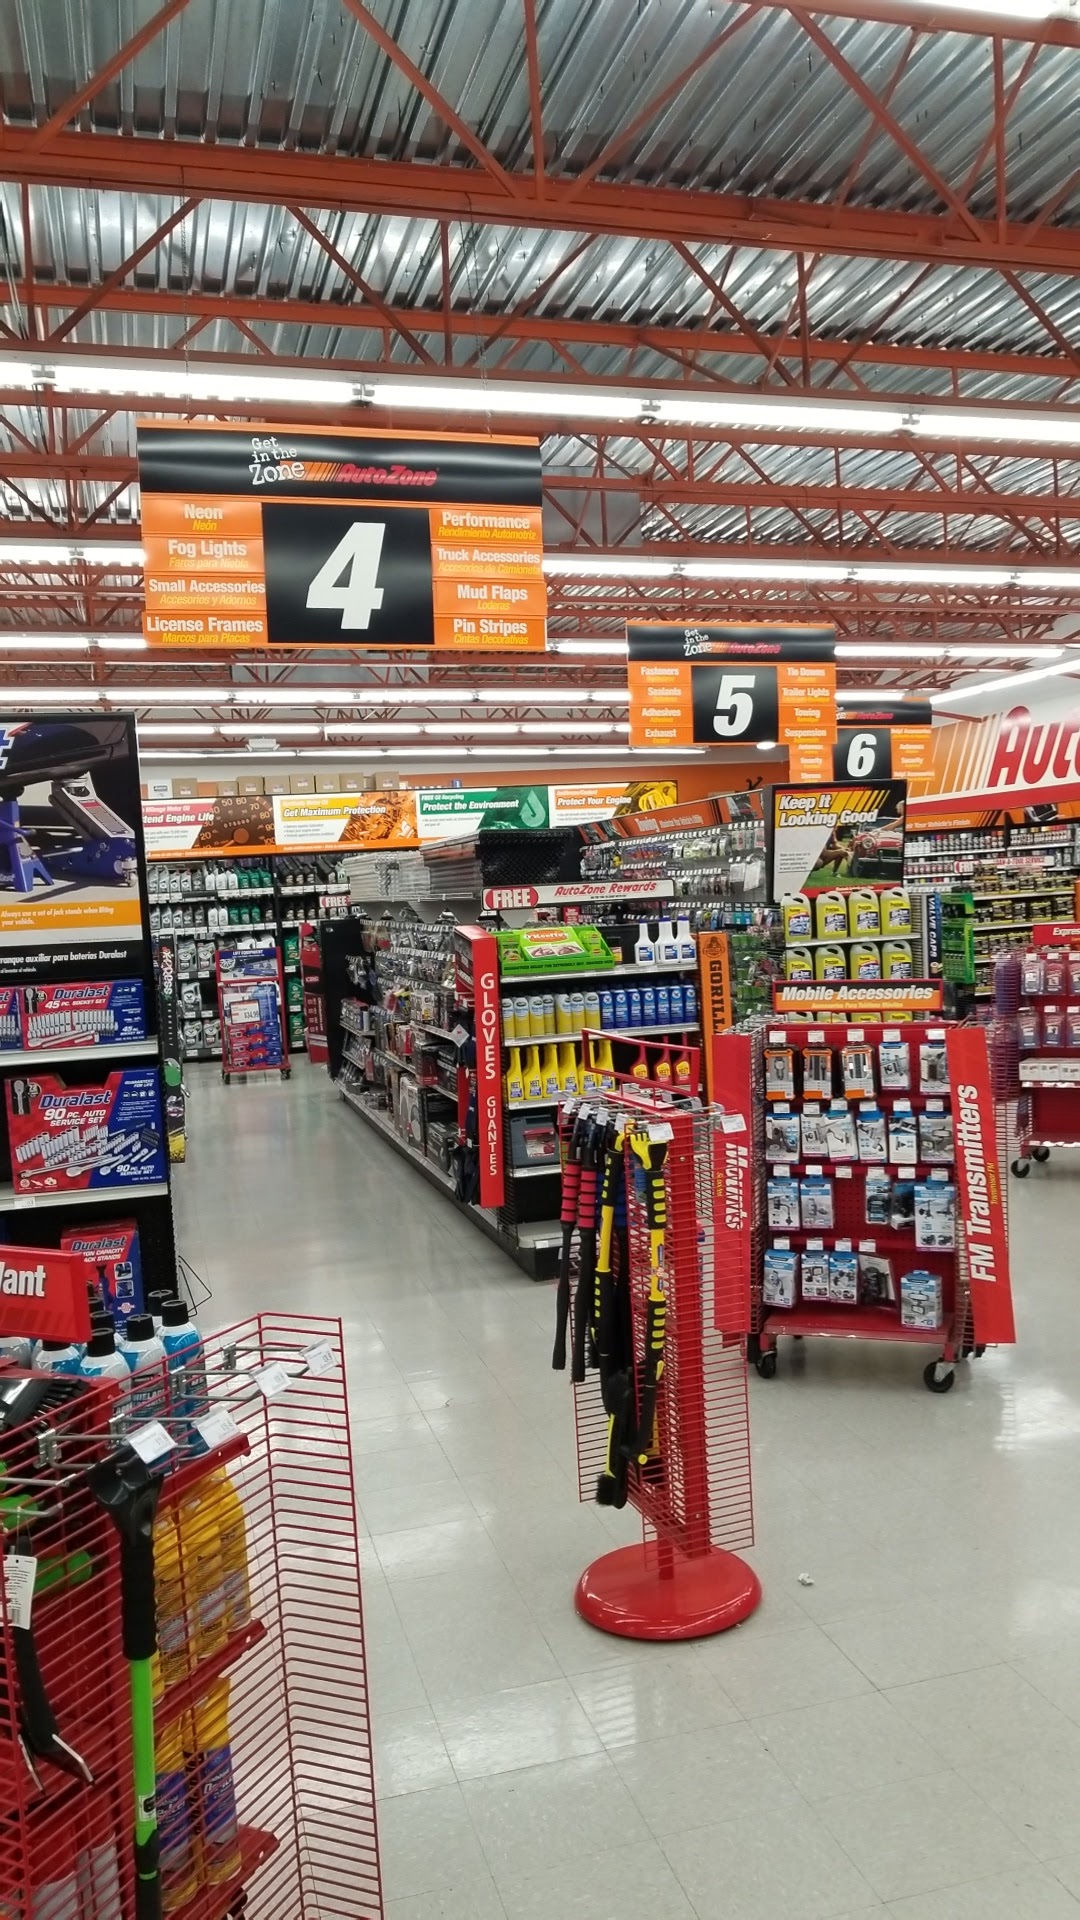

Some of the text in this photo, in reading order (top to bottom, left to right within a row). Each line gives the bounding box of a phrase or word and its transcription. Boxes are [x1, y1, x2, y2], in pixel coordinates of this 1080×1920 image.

[251, 436, 278, 449] Get
[252, 447, 298, 463] in the
[249, 461, 305, 485] Zone
[336, 463, 437, 486] AutoZone
[184, 504, 223, 520] Neon
[193, 520, 216, 531] Neón
[442, 512, 530, 529] Performance
[438, 527, 536, 540] Rendimiento Automotriz
[168, 540, 247, 558] Fog Lights
[436, 548, 540, 563] Truck Accessories
[197, 559, 219, 570] para
[486, 564, 496, 574] de
[306, 521, 386, 630] 4
[149, 580, 266, 594] Small Accessories
[457, 585, 528, 602] Mud Flaps
[160, 594, 256, 607] Accesorios y Adornos
[478, 601, 510, 611] Loderas
[147, 618, 264, 632] License Frames
[453, 619, 527, 636] Pin Stripes
[162, 632, 250, 645] Marcos para Placas
[454, 634, 528, 645] Cintas Decorativas
[684, 642, 712, 656] Zone
[640, 666, 679, 676] Fasteners
[782, 688, 830, 697] Trailer Lights
[642, 708, 681, 717] Adhesives
[713, 674, 756, 737] 5
[794, 708, 821, 718] Towing
[645, 729, 677, 738] Exhaust
[784, 728, 827, 738] Suspension
[846, 734, 877, 777] 6
[222, 799, 233, 807] 50
[236, 797, 247, 805] 60
[250, 803, 260, 811] 70
[260, 811, 270, 819] 80
[423, 800, 519, 811] Protect the Environment
[557, 796, 632, 806] Protect Your Engine
[779, 794, 832, 812] Keep It
[166, 812, 214, 824] Engine Life
[284, 806, 387, 817] Get Maximum Protection
[780, 808, 879, 827] Looking Good
[326, 897, 347, 906] FREE
[493, 888, 532, 908] FREE
[555, 884, 606, 897] AutoZone
[608, 881, 657, 894] Rewards
[928, 897, 938, 958] VALVE CAPS
[53, 954, 68, 964] para
[99, 950, 127, 959] Duralast
[53, 985, 109, 1000] Duralast
[710, 960, 726, 1034] GORILL
[782, 985, 933, 1001] Mobile Accessories
[45, 1001, 60, 1009] 45
[480, 972, 497, 1080] GLOVES
[39, 1091, 113, 1109] Duralast
[44, 1108, 67, 1121] 90
[50, 1119, 86, 1127] SERVICE
[487, 1096, 498, 1176] GUANTES
[116, 1165, 131, 1173] 90
[725, 1142, 748, 1230] Mounts
[957, 1084, 997, 1282] FM Transmitters
[71, 1235, 127, 1251] Duralast
[96, 1248, 125, 1256] CAPACITY
[97, 1254, 121, 1262] STANDS
